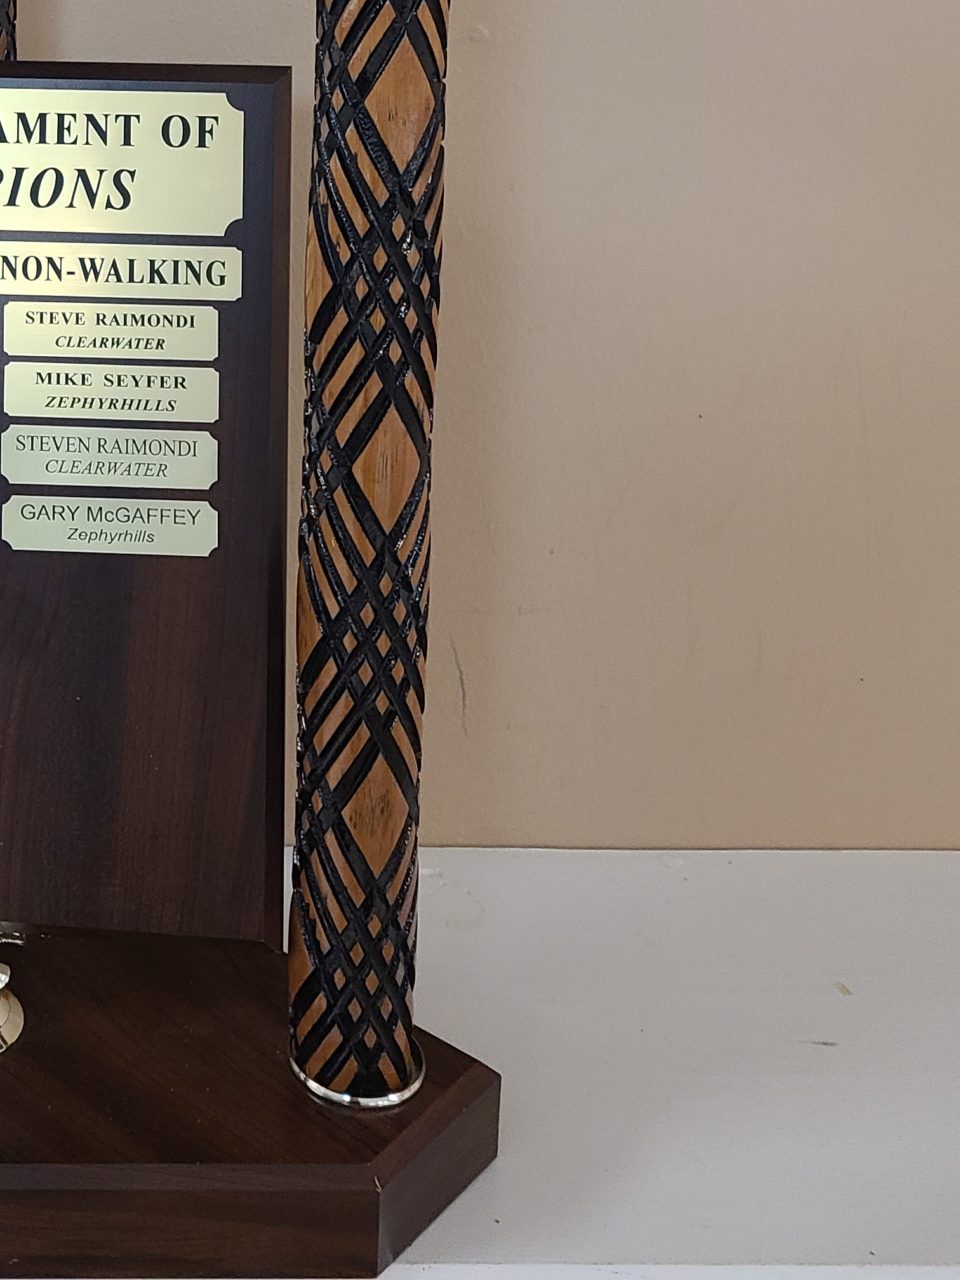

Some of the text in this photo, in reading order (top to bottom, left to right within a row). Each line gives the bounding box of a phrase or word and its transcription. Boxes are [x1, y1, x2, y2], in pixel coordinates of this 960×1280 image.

[160, 114, 220, 149] OF
[0, 255, 228, 287] NON-WALKING
[25, 311, 196, 328] STEVE RAIMONDI
[54, 335, 166, 350] CLEARWATER
[35, 371, 188, 389] MIKE SEYFER
[44, 396, 177, 412] ZEPHYRHILLS
[15, 435, 198, 457] STEVEN RAIMONDI
[45, 459, 168, 477] CLEARWATER
[20, 504, 202, 525] GARY McGAFFEY
[67, 528, 155, 544] Zephyrhills
